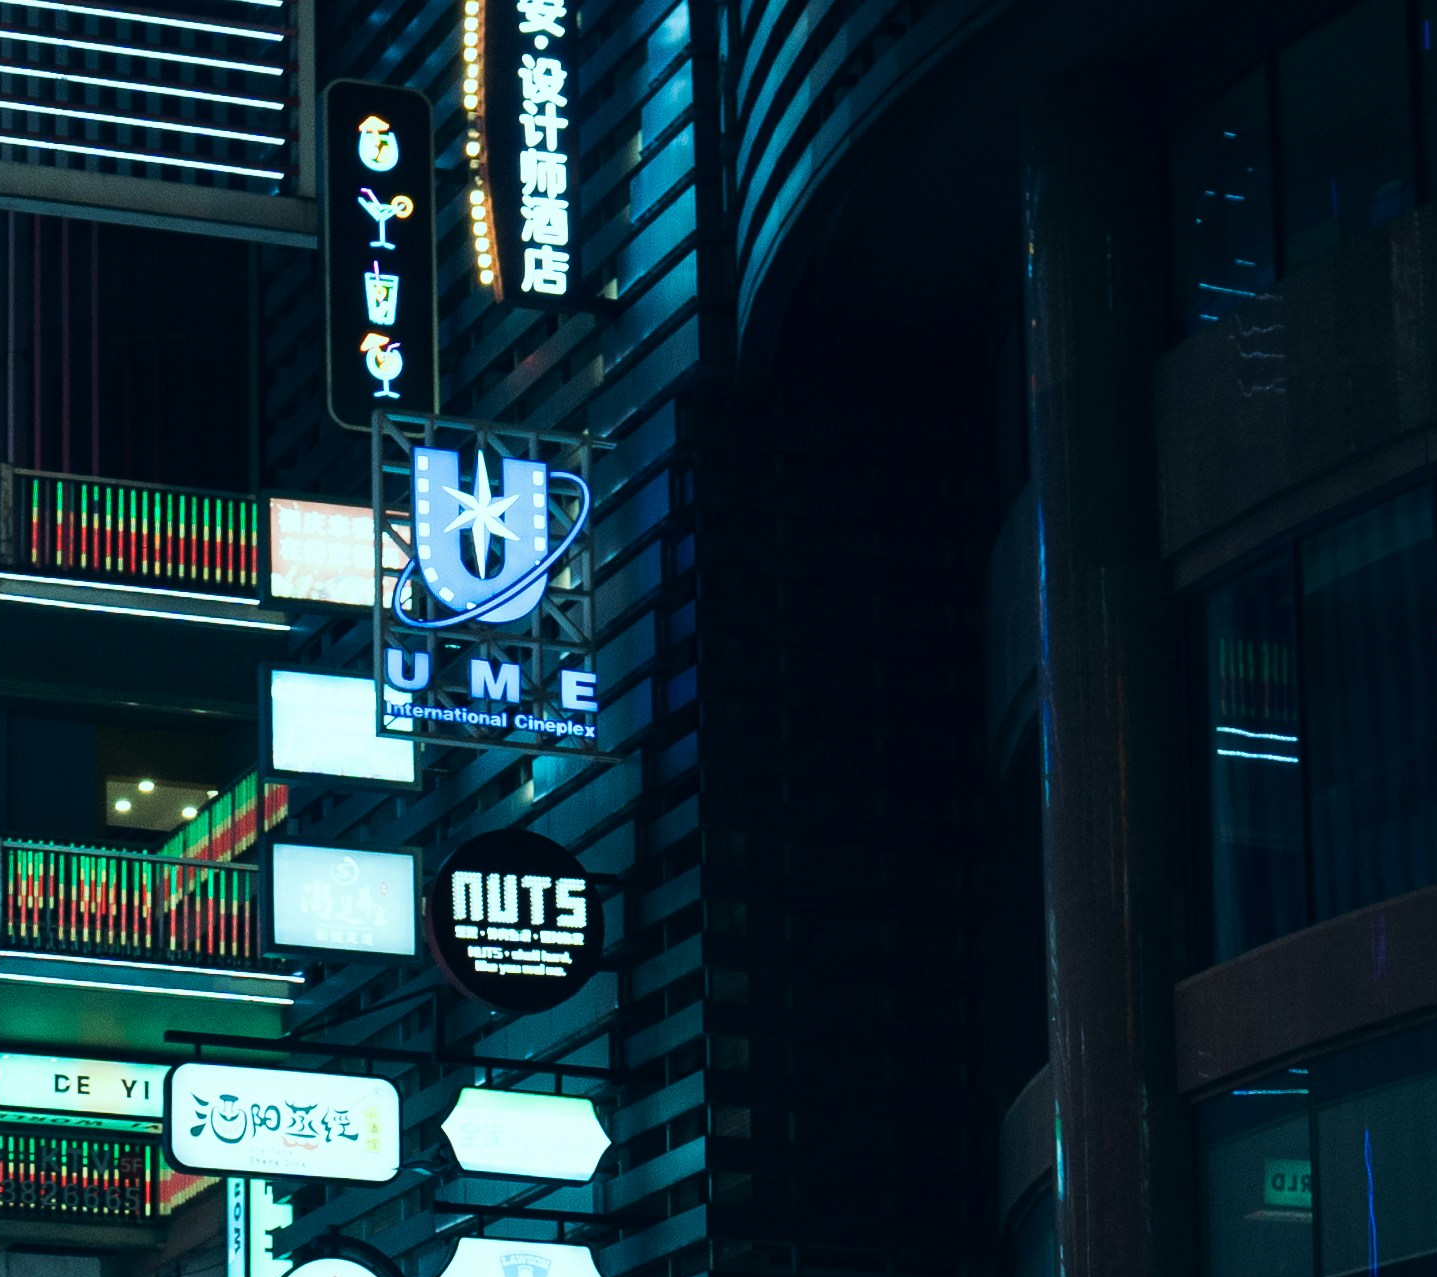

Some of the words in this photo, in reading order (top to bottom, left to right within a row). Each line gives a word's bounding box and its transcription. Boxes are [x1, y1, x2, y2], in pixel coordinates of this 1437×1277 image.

[385, 698, 509, 730] International
[513, 713, 597, 739] Cineplex
[452, 870, 587, 929] NUTS
[52, 1072, 91, 1098] DE
